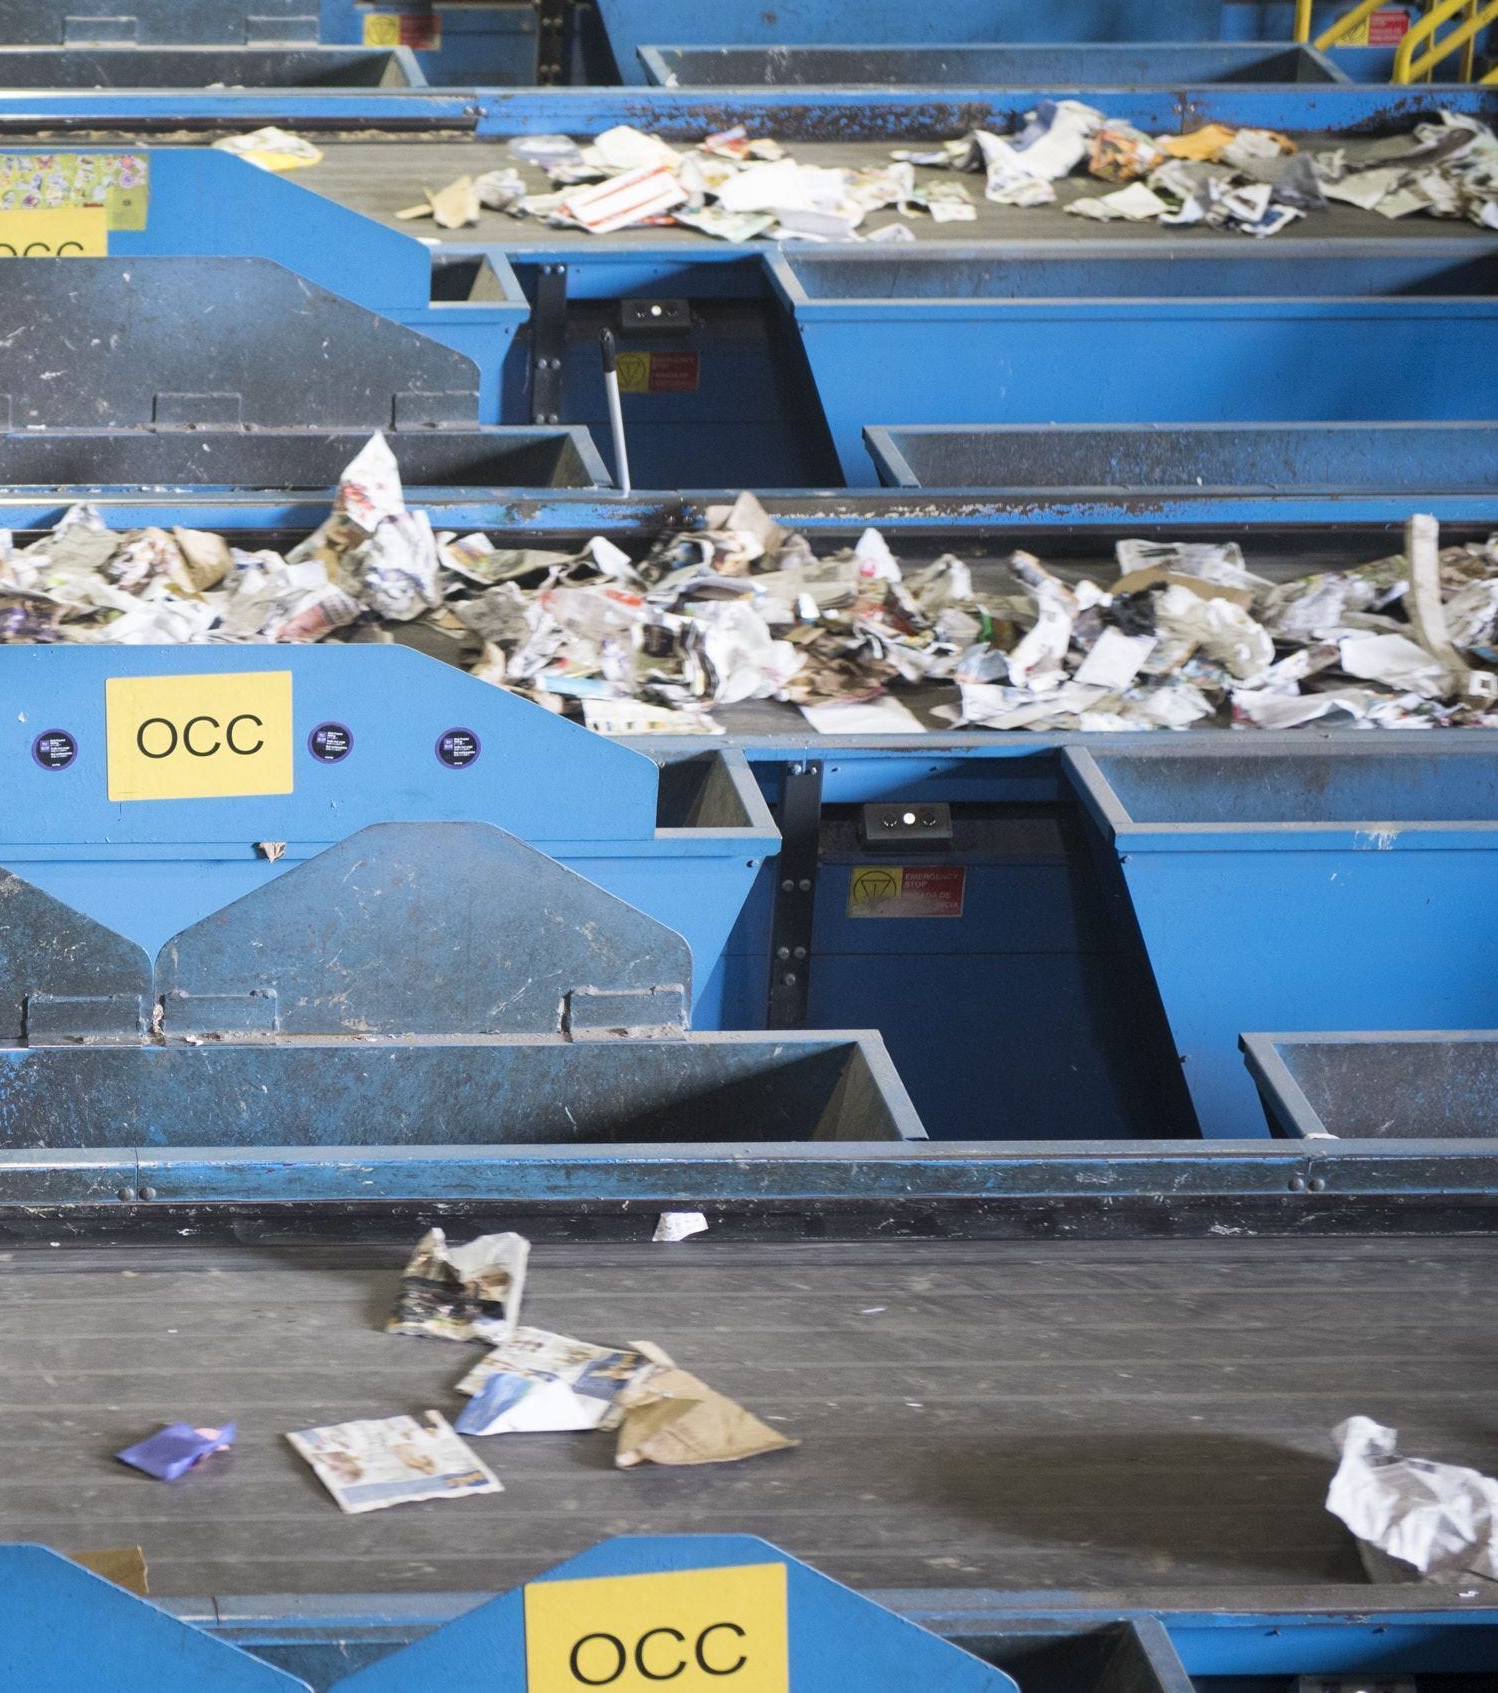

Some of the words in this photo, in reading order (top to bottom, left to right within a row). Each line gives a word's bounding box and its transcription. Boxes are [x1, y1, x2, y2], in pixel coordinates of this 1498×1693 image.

[137, 714, 264, 759] OCC
[904, 881, 927, 889] STOP
[905, 872, 959, 881] EMERGENCY
[569, 1622, 748, 1686] OCC
